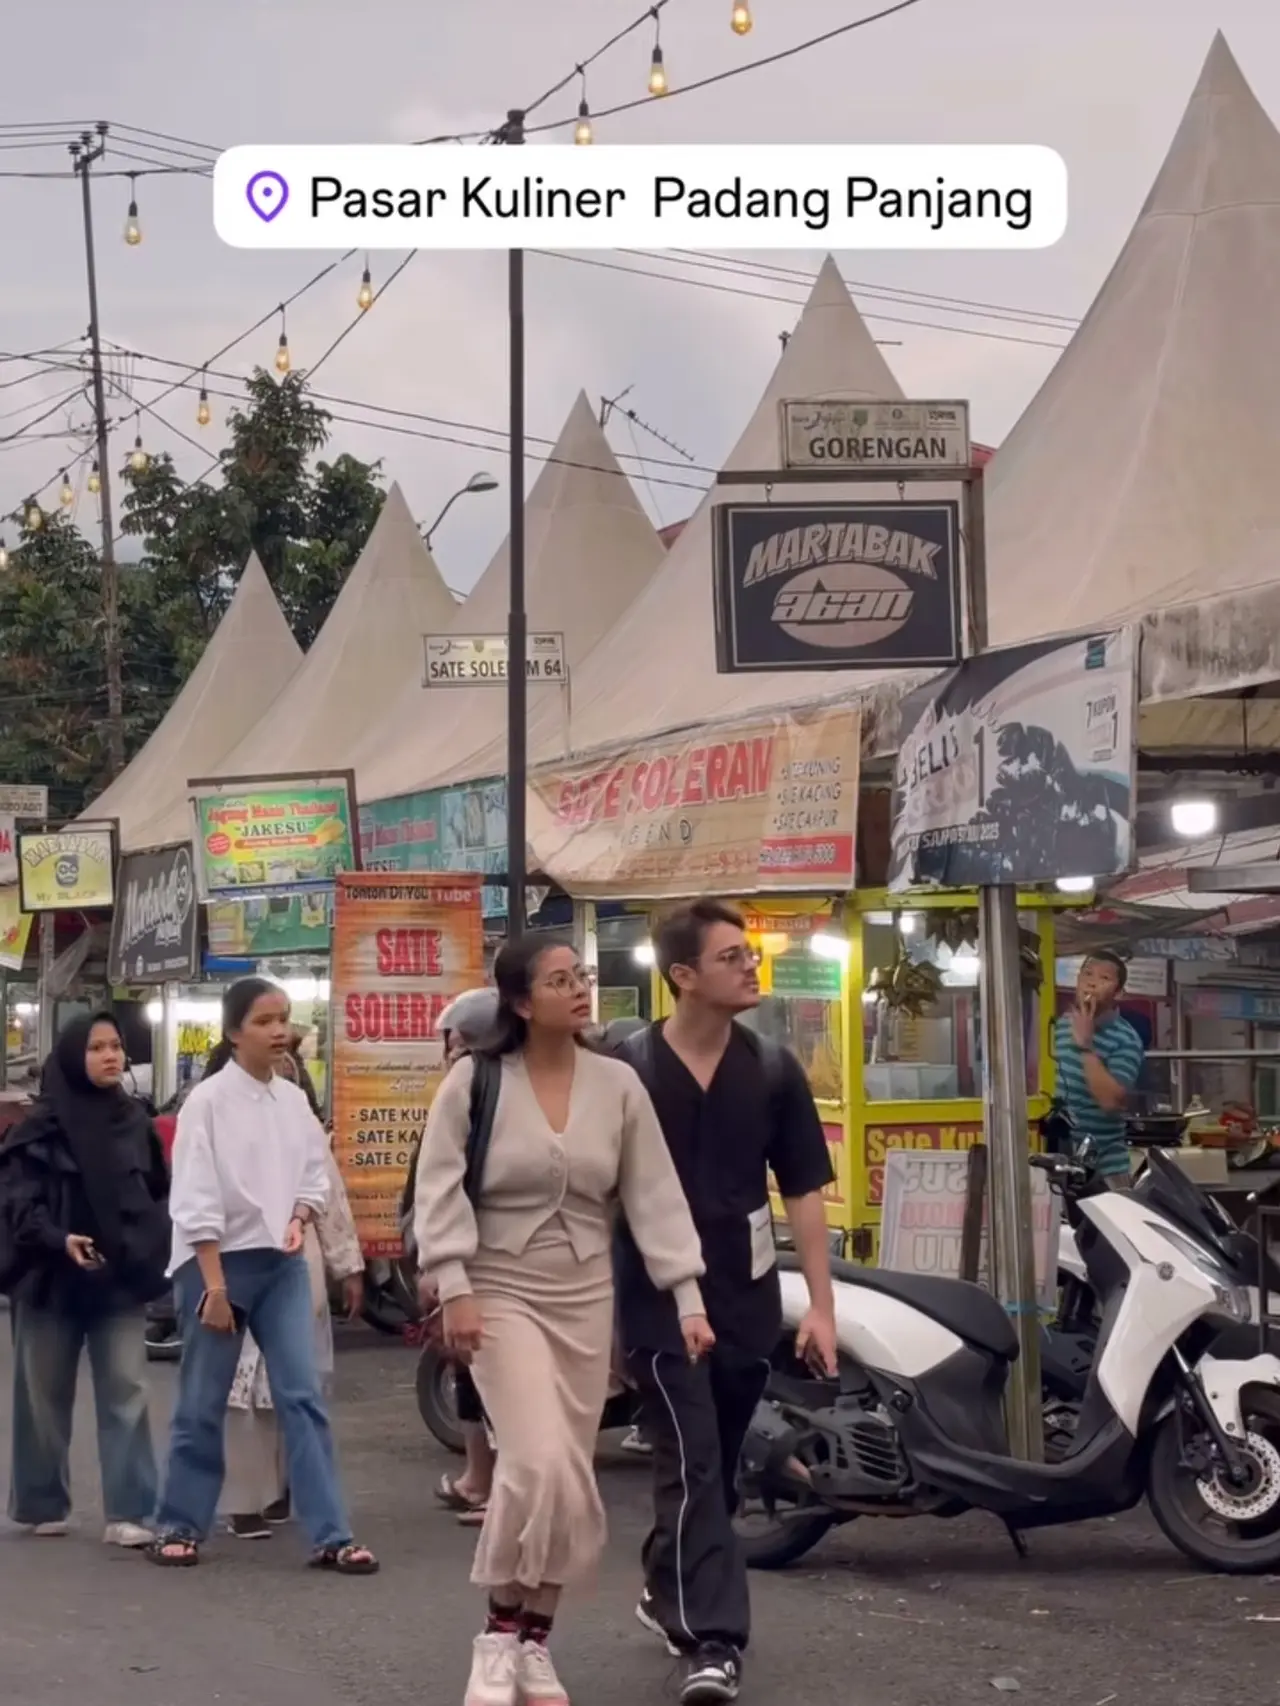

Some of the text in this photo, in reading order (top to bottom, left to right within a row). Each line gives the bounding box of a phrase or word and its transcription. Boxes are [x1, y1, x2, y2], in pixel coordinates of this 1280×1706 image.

[808, 436, 947, 459] GORENGAN
[742, 521, 942, 588] MARTABAK
[430, 659, 562, 678] SATE SOLEM 64
[375, 927, 443, 977] SATE
[345, 991, 450, 1042] SOLER
[359, 1108, 397, 1122] SATE
[356, 1129, 421, 1144] SATE KA
[355, 1152, 392, 1166] SATE
